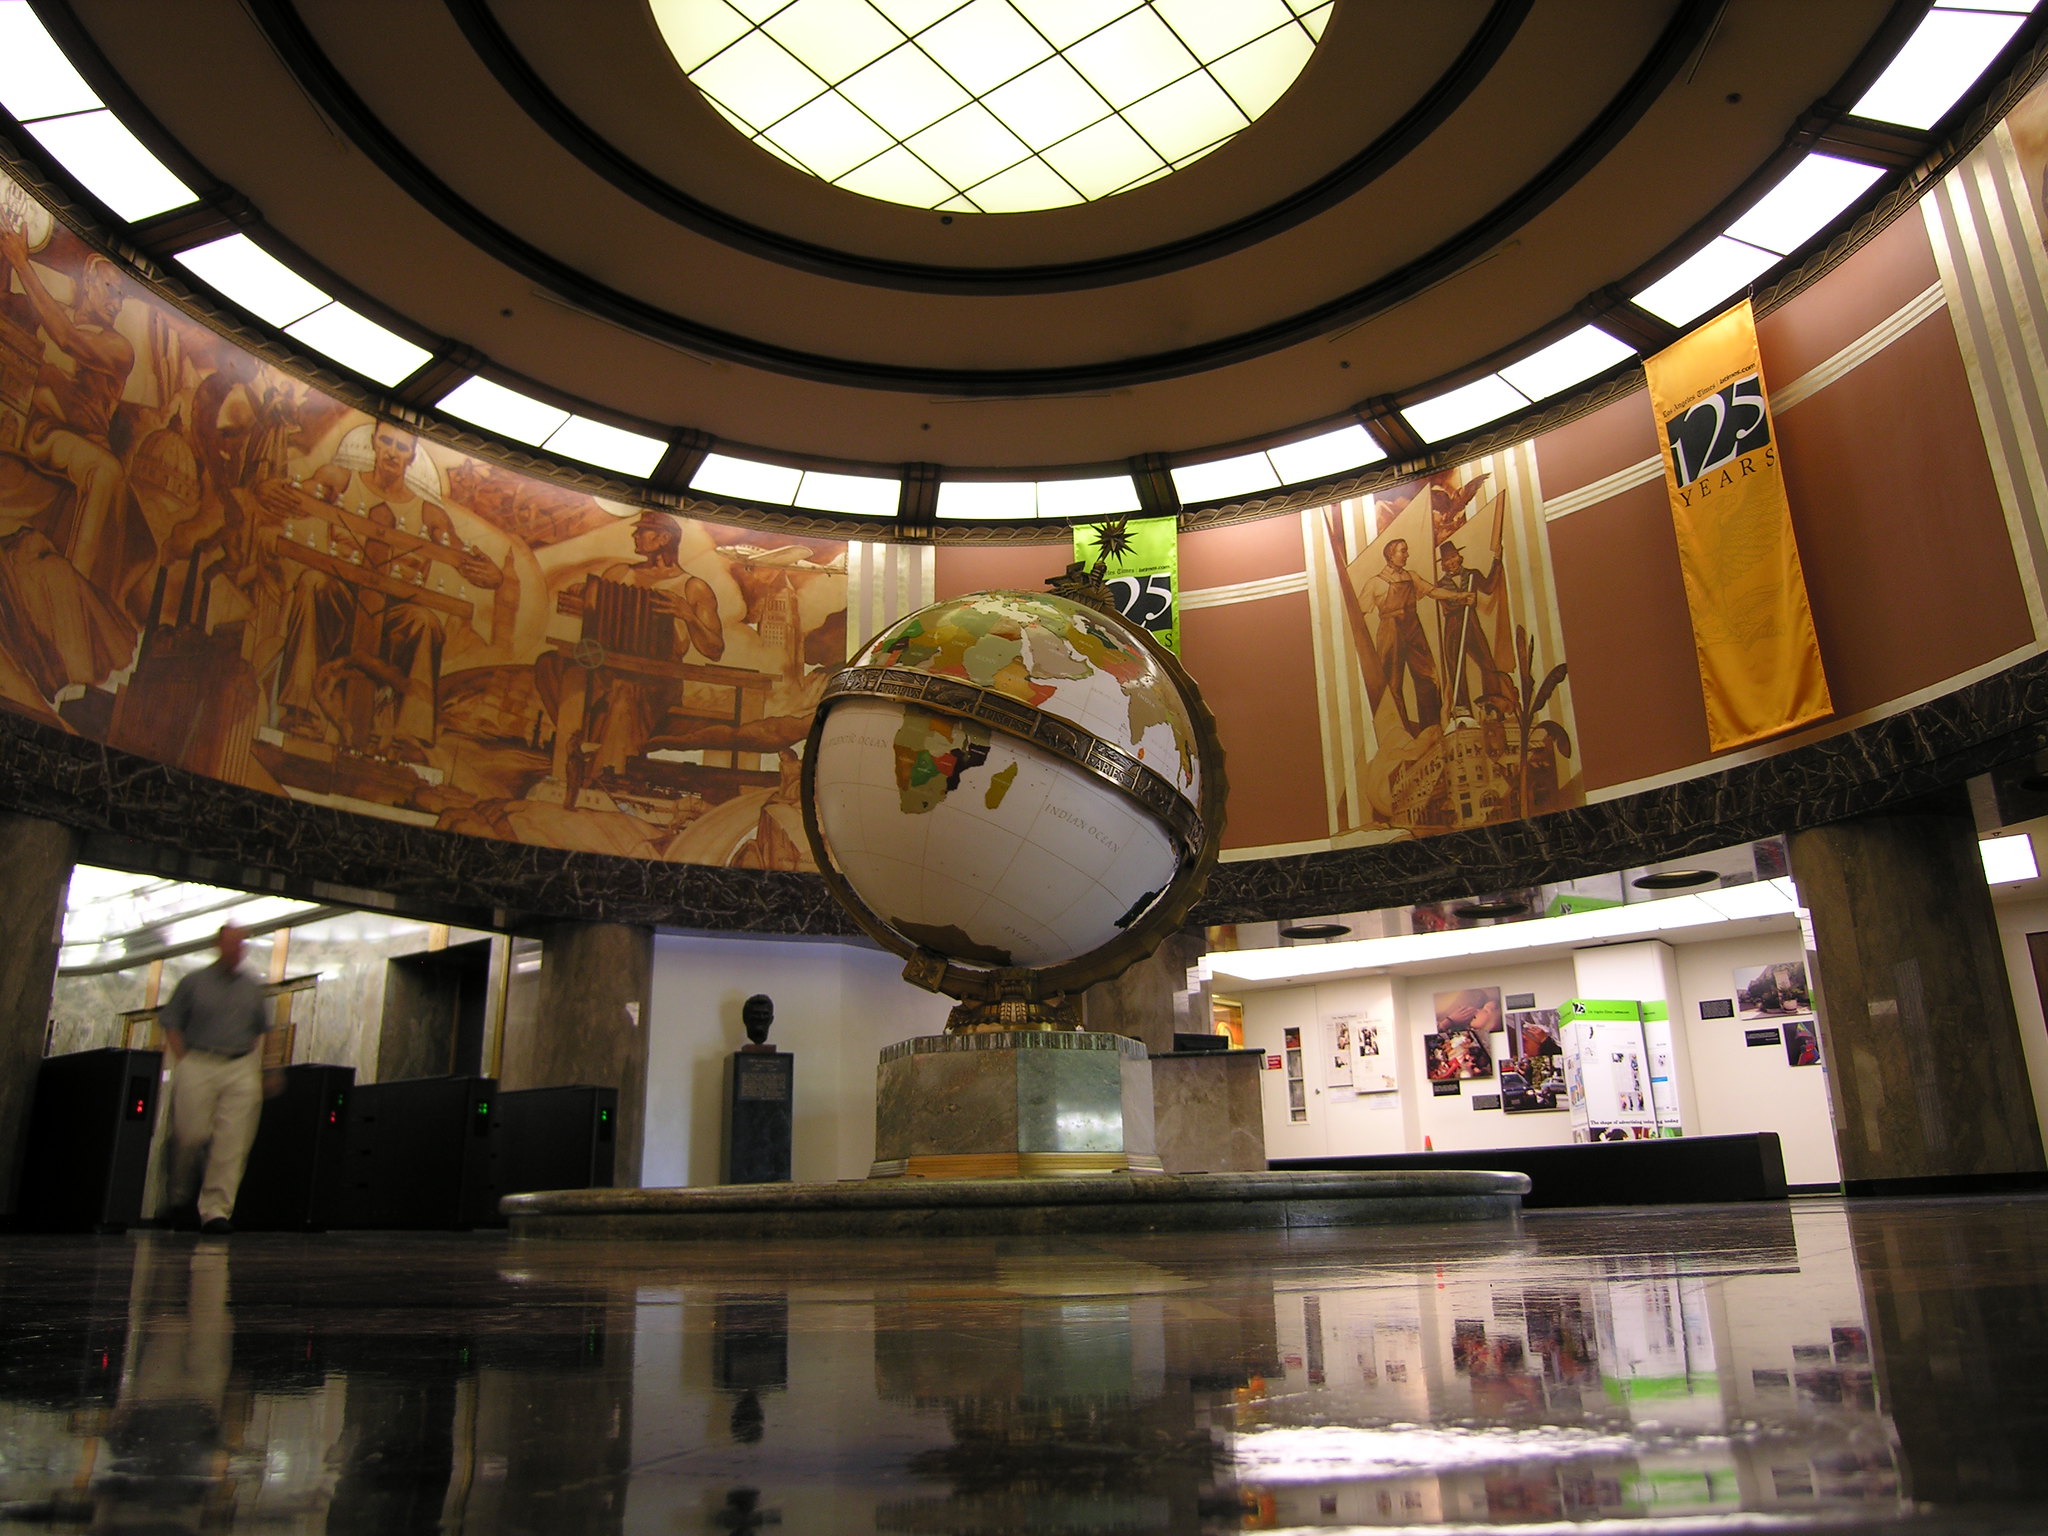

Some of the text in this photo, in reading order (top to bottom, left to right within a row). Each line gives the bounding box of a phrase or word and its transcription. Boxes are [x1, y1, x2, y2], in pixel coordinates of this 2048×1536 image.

[1696, 383, 1716, 398] Times
[1670, 372, 1766, 488] 125
[1679, 447, 1776, 508] YEARS
[1104, 573, 1173, 629] 25
[984, 710, 1023, 730] PISCES
[1094, 760, 1126, 783] ARIES
[1045, 803, 1120, 853] INDIAN OCEAN
